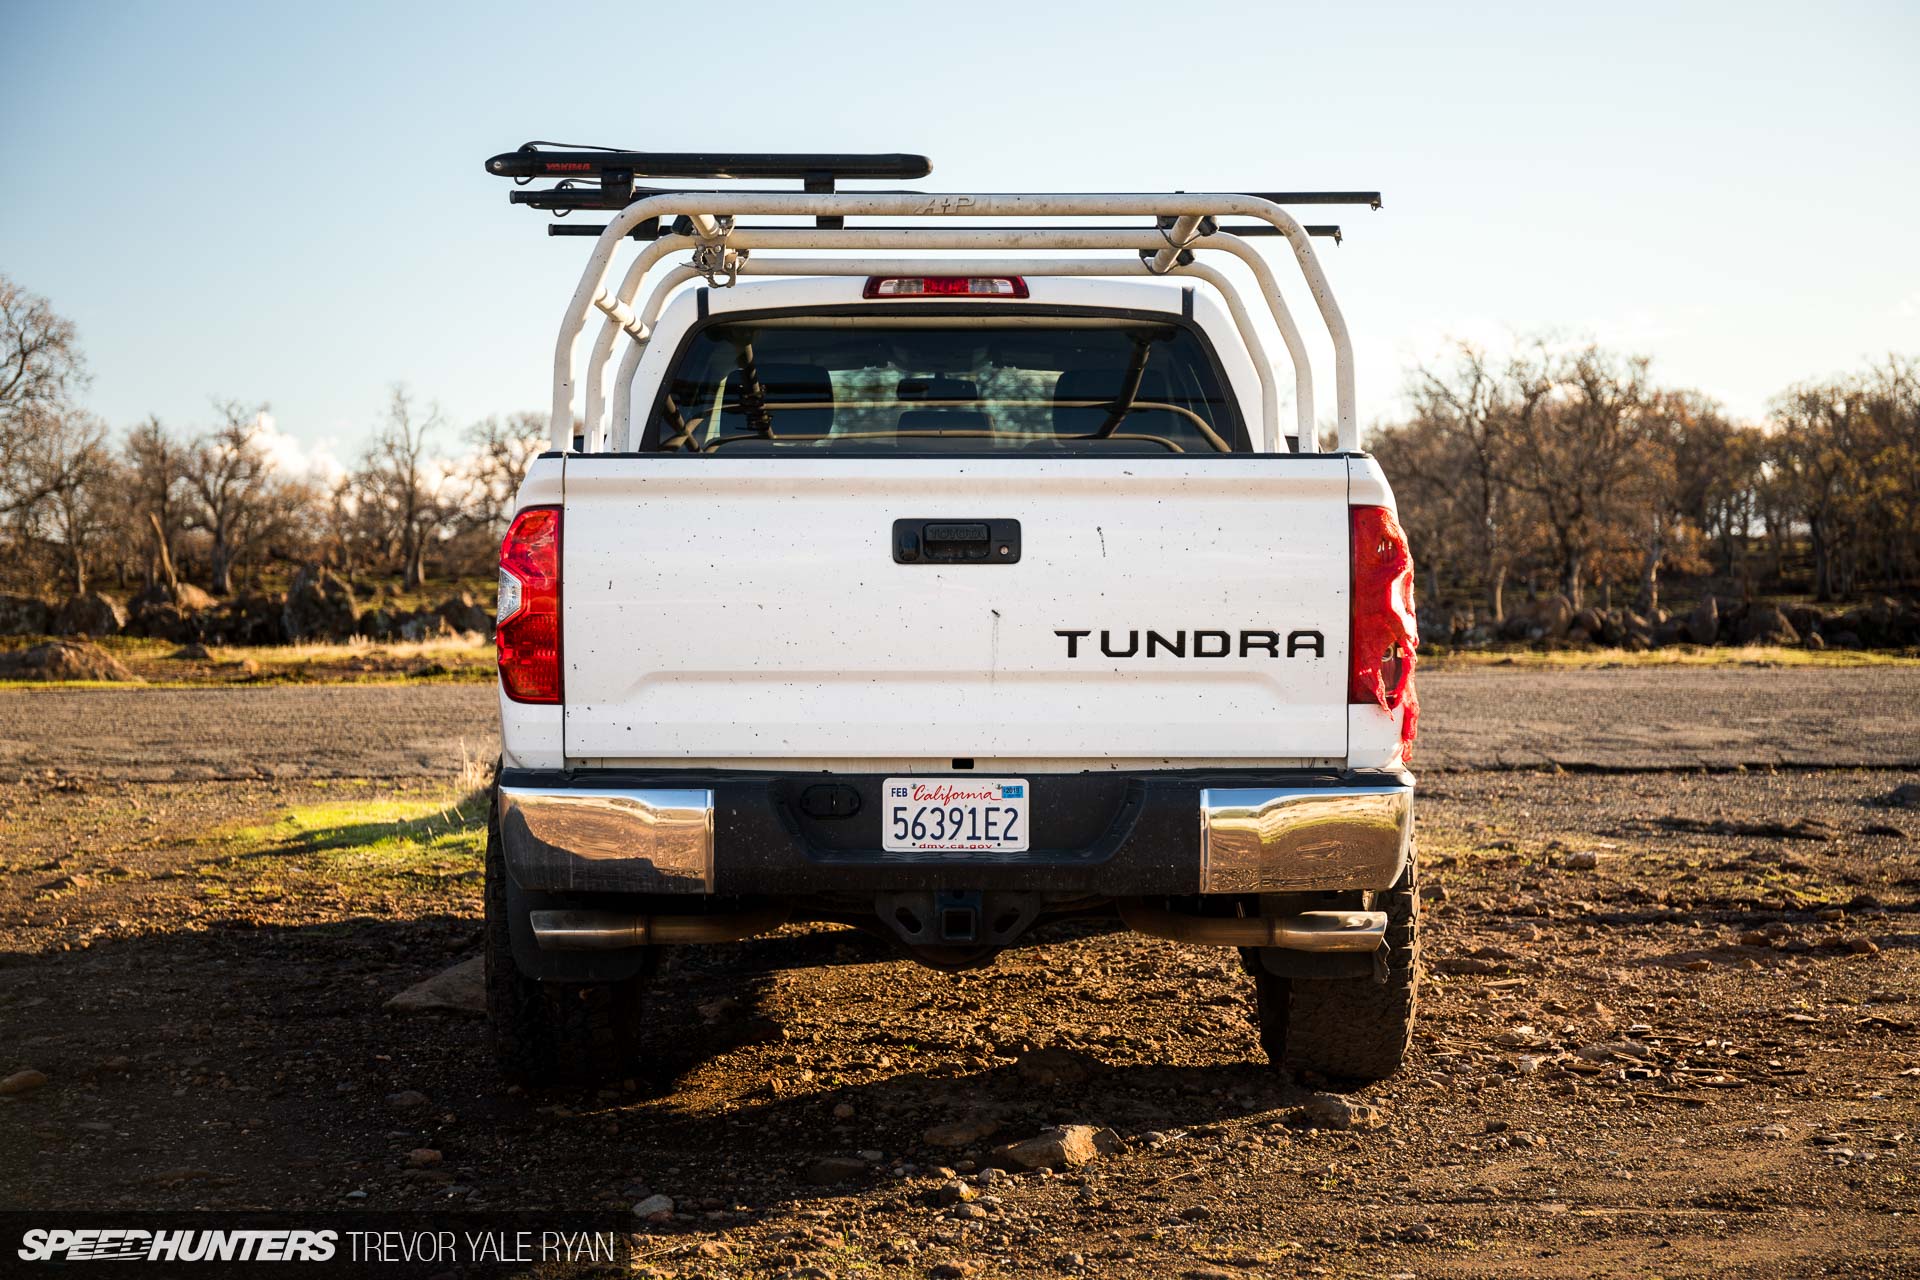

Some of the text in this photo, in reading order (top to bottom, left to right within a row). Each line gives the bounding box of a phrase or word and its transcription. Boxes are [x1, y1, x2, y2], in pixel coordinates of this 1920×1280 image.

[1053, 630, 1325, 658] TUNDRA
[891, 788, 908, 798] FEB
[913, 784, 1002, 806] California
[893, 807, 1019, 841] 56391E2
